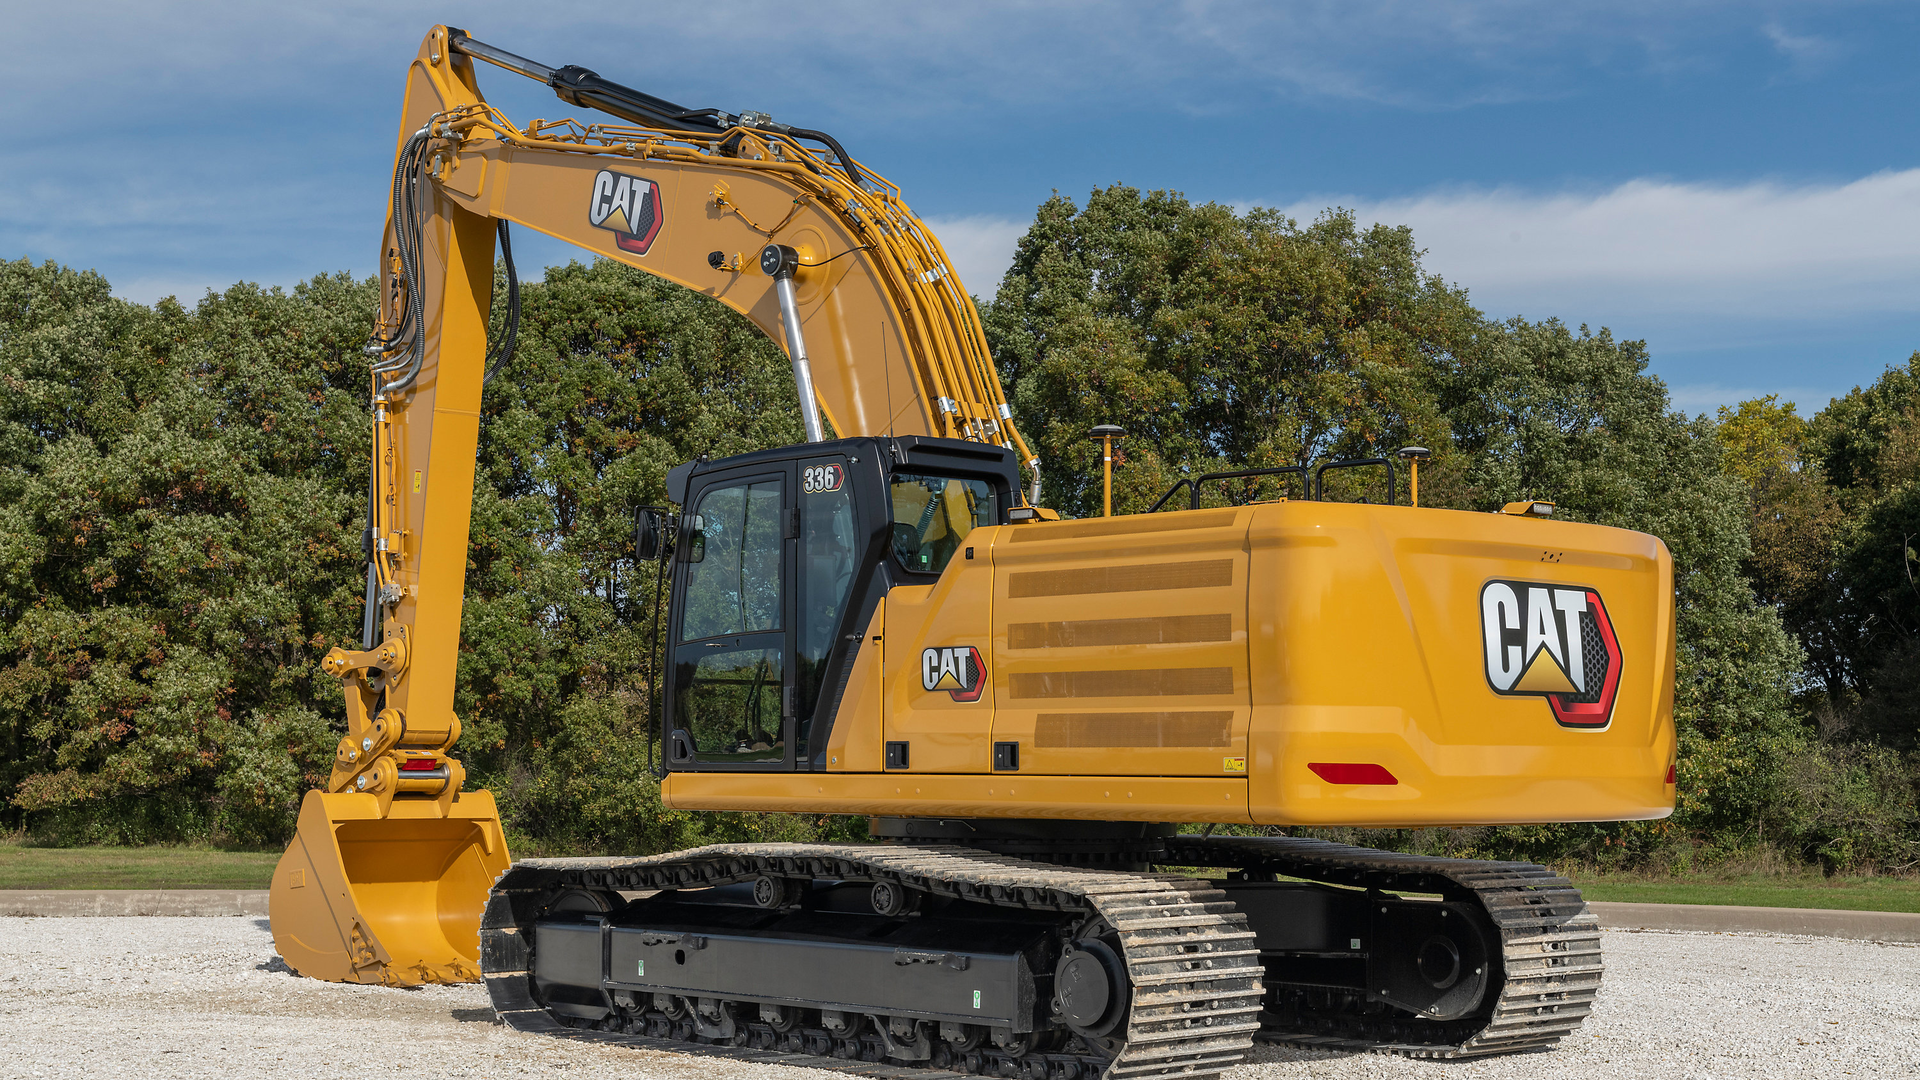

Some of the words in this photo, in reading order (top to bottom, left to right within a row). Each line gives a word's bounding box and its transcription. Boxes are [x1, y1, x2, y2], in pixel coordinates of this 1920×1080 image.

[590, 170, 651, 235] CAT
[804, 466, 835, 491] 336
[1482, 582, 1588, 693] CAT
[922, 647, 970, 690] CAT
